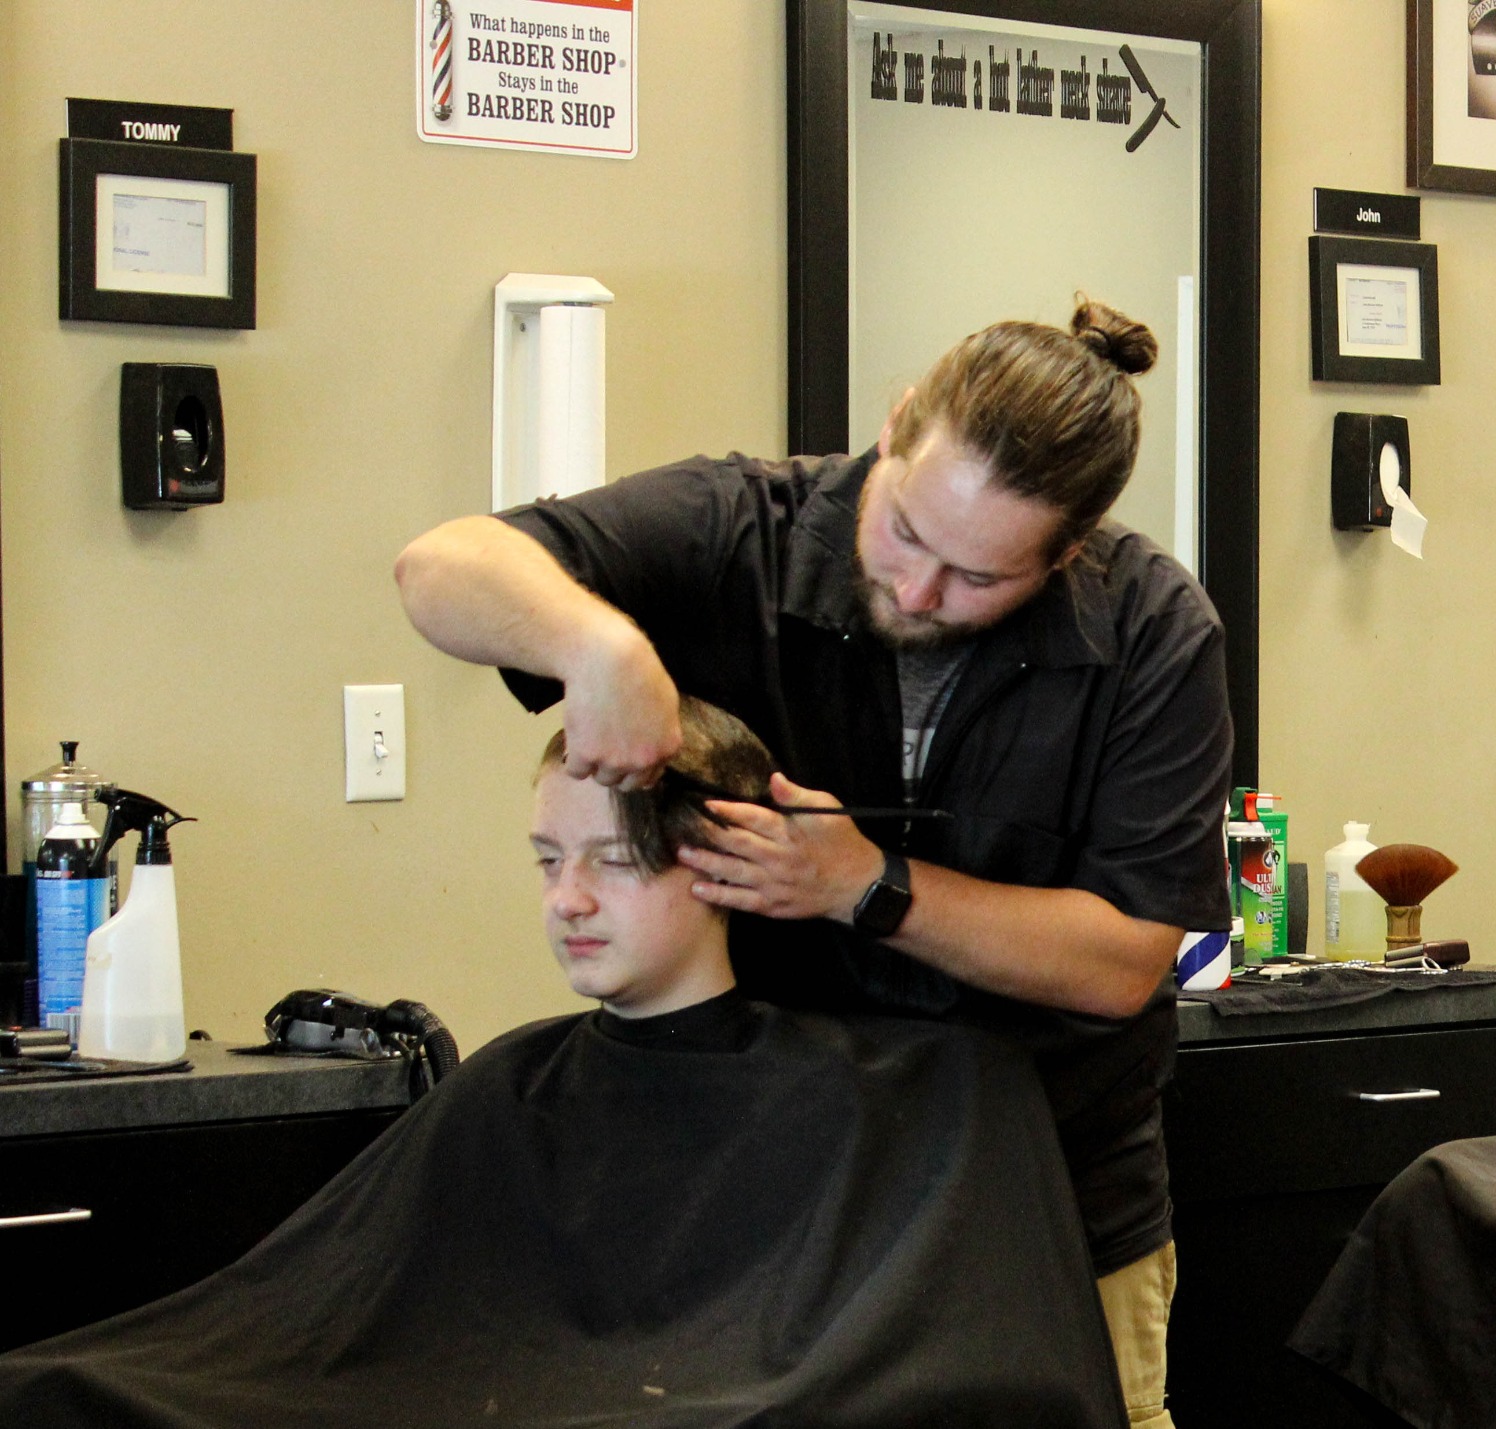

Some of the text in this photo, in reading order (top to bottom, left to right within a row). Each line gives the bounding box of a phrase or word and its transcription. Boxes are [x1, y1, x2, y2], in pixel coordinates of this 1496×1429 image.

[470, 12, 610, 43] What happens in the
[467, 37, 616, 75] BARBER SHOP
[498, 71, 579, 95] Stays in the
[467, 92, 616, 130] BARBER SHOP
[121, 121, 181, 142] TOMMY
[1356, 207, 1381, 224] John
